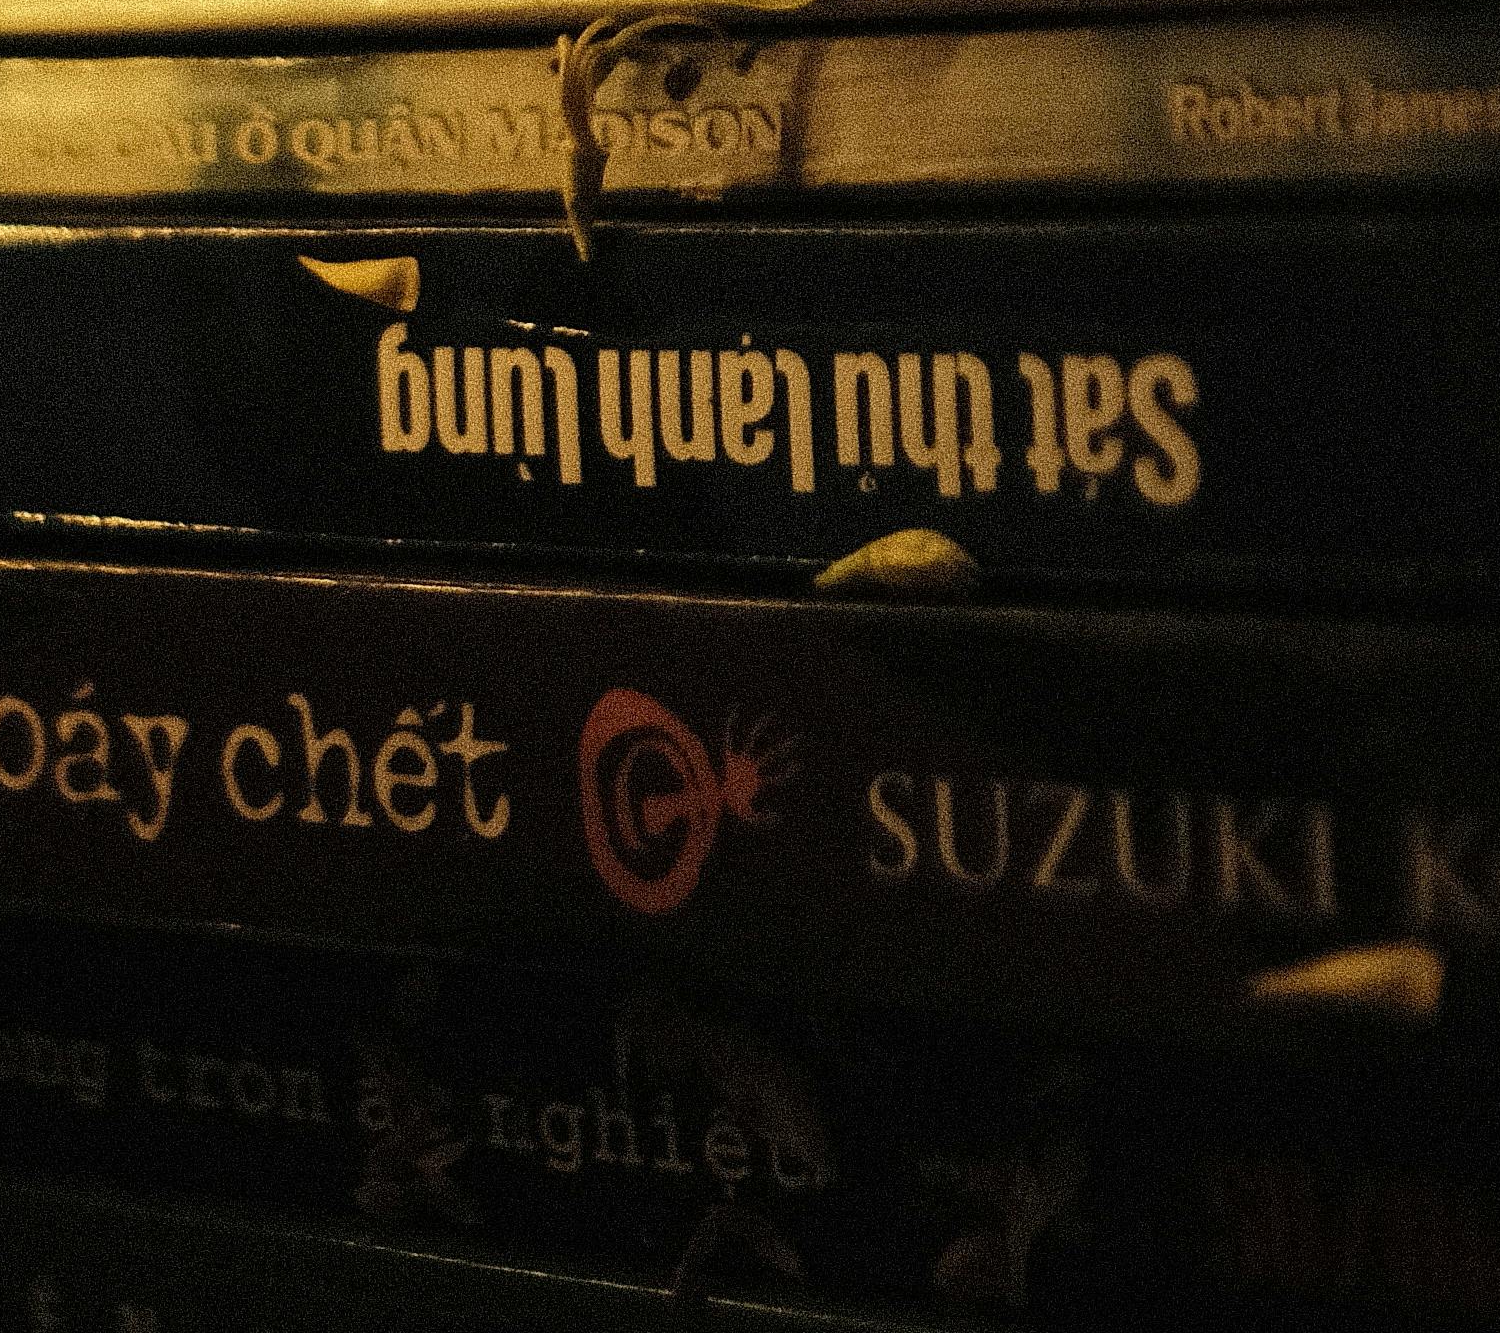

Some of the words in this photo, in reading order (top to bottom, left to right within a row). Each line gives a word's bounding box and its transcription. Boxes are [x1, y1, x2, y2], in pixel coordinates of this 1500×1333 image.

[1165, 79, 1345, 145] Robert
[373, 319, 585, 491] lùng
[596, 330, 818, 495] lạnh
[830, 345, 1000, 502] thủ
[1015, 345, 1204, 512] Sát
[216, 689, 512, 844] chết
[864, 770, 1341, 922] SUZUKI
